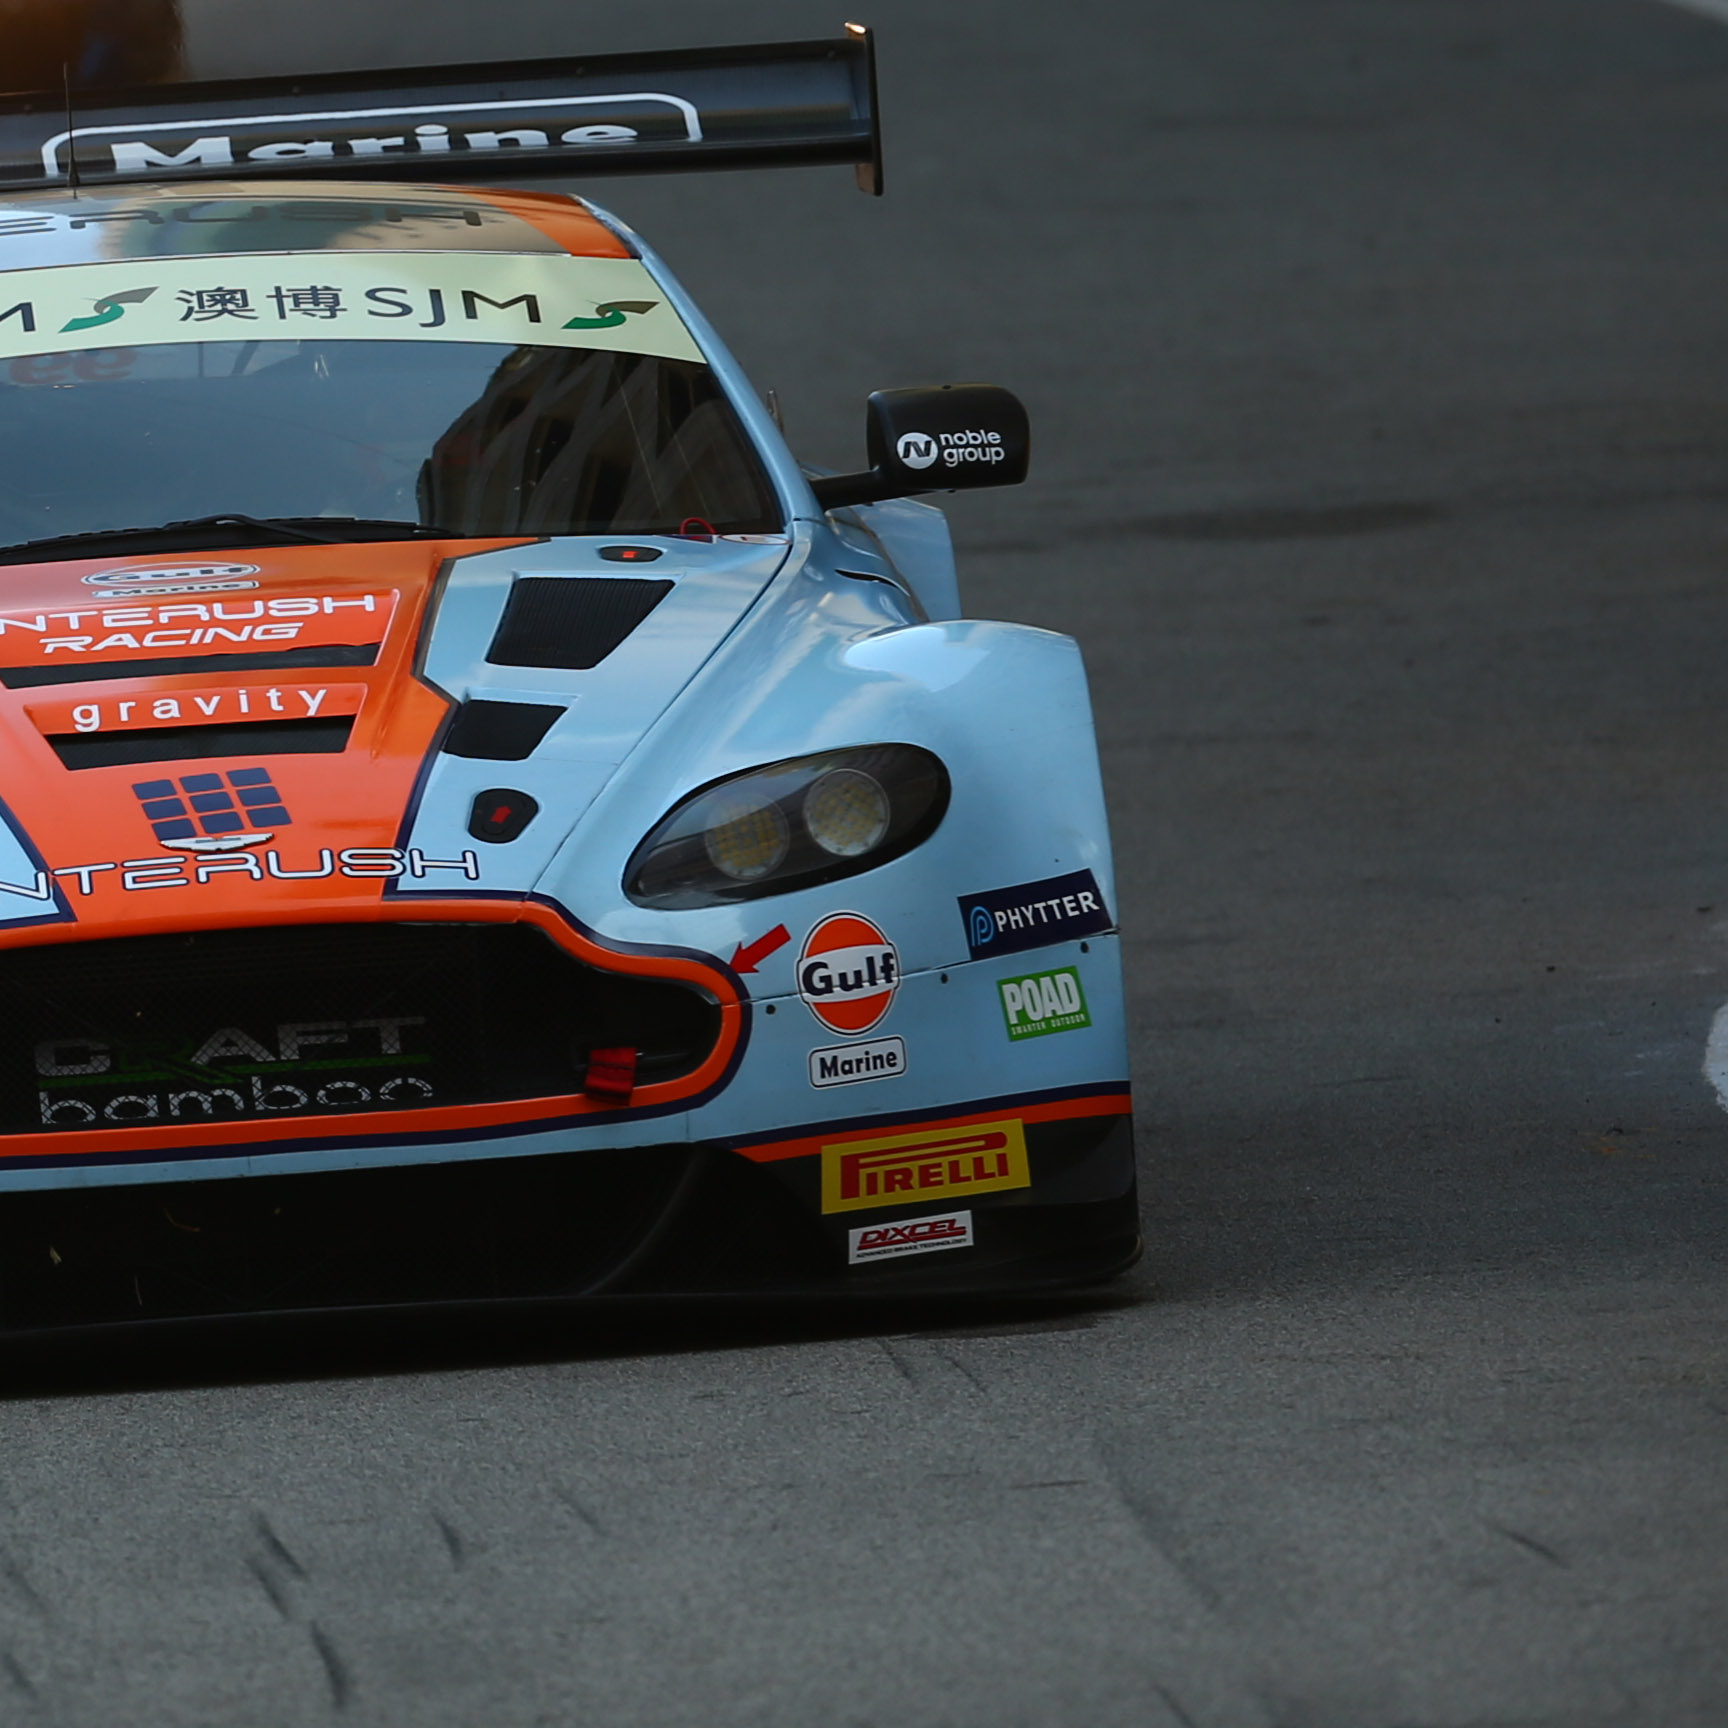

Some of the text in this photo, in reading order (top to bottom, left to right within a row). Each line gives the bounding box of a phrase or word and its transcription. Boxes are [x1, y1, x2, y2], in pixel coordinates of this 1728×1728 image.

[112, 124, 638, 169] Marine
[939, 429, 1001, 446] noble
[944, 446, 1005, 467] group
[112, 583, 240, 596] Marine
[40, 622, 304, 654] RACING
[72, 688, 327, 732] gravity
[994, 891, 1100, 932] PHYTTER
[802, 952, 895, 996] Gulf
[1002, 973, 1081, 1024] POAD
[819, 1050, 898, 1078] Marine
[841, 1132, 1009, 1200] PIRELLI
[858, 1218, 966, 1247] DIXCEL
